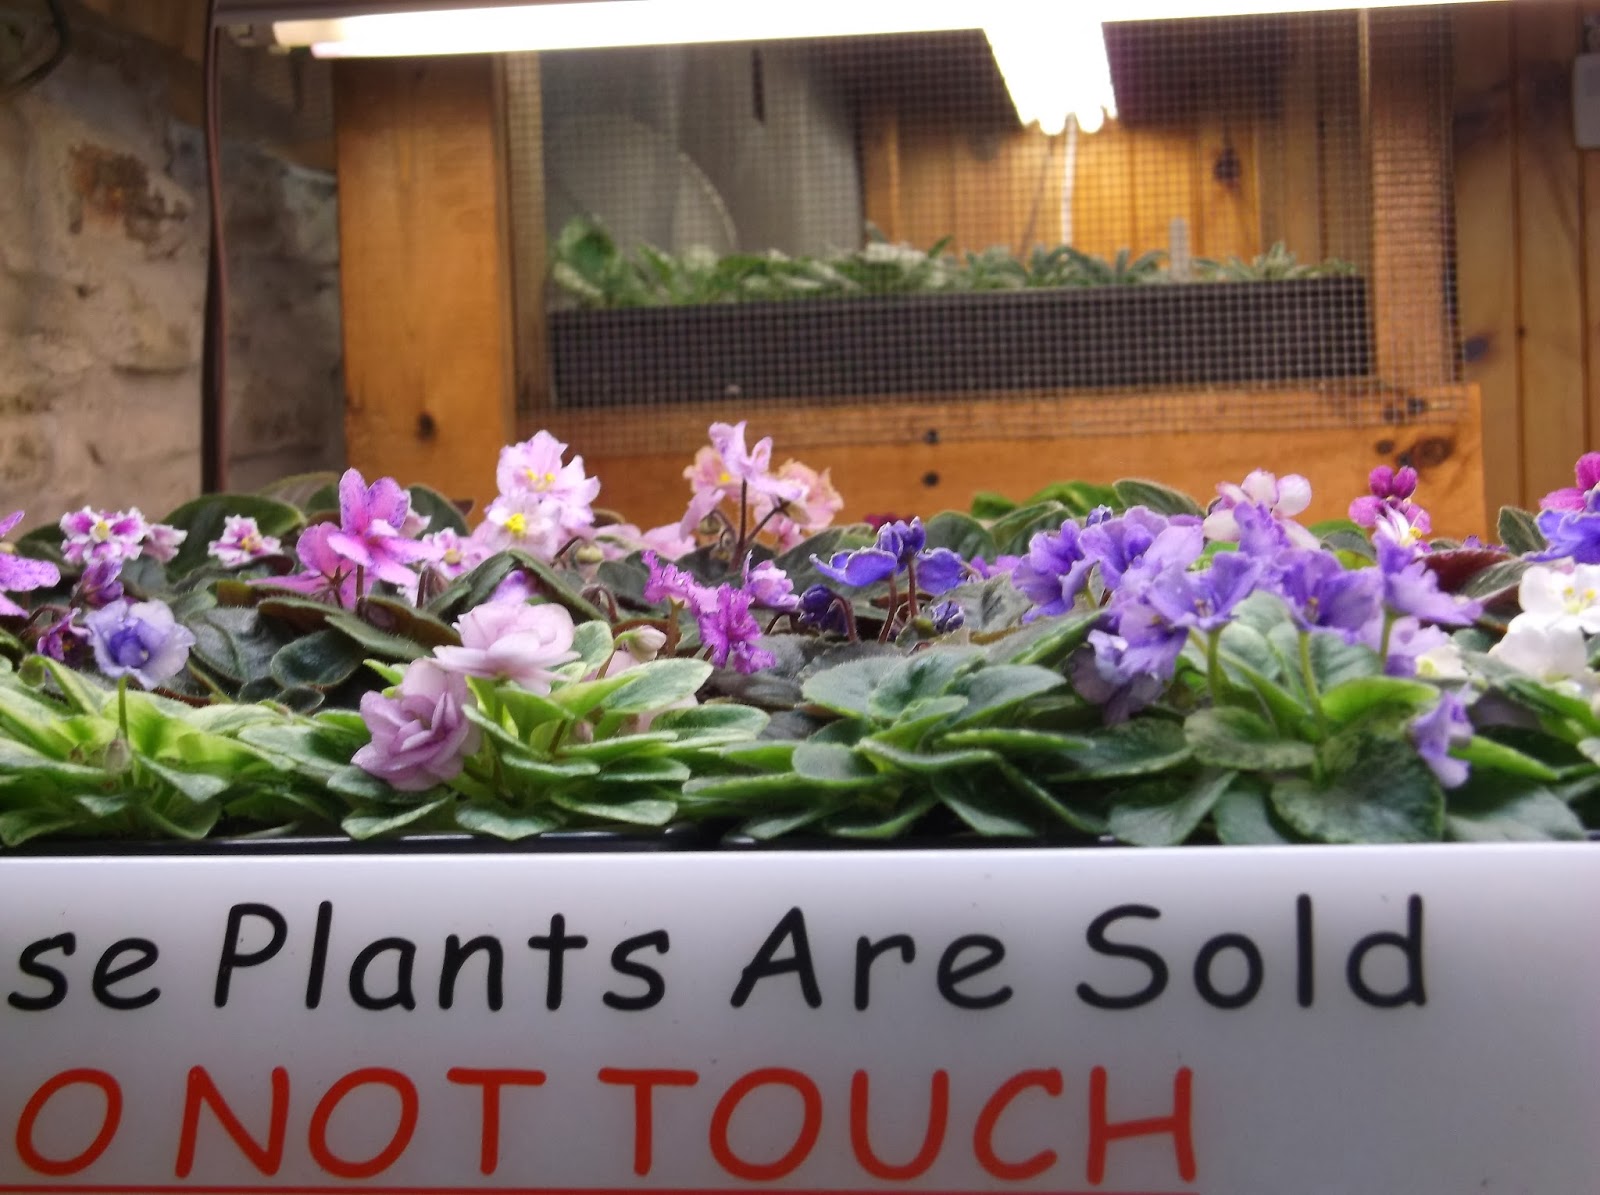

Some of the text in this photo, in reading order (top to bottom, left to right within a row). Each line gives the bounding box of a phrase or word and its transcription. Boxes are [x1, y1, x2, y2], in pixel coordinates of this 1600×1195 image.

[6, 892, 1428, 1013] se Plants Are Sold
[15, 1064, 1198, 1184] O NOT TOUCH
